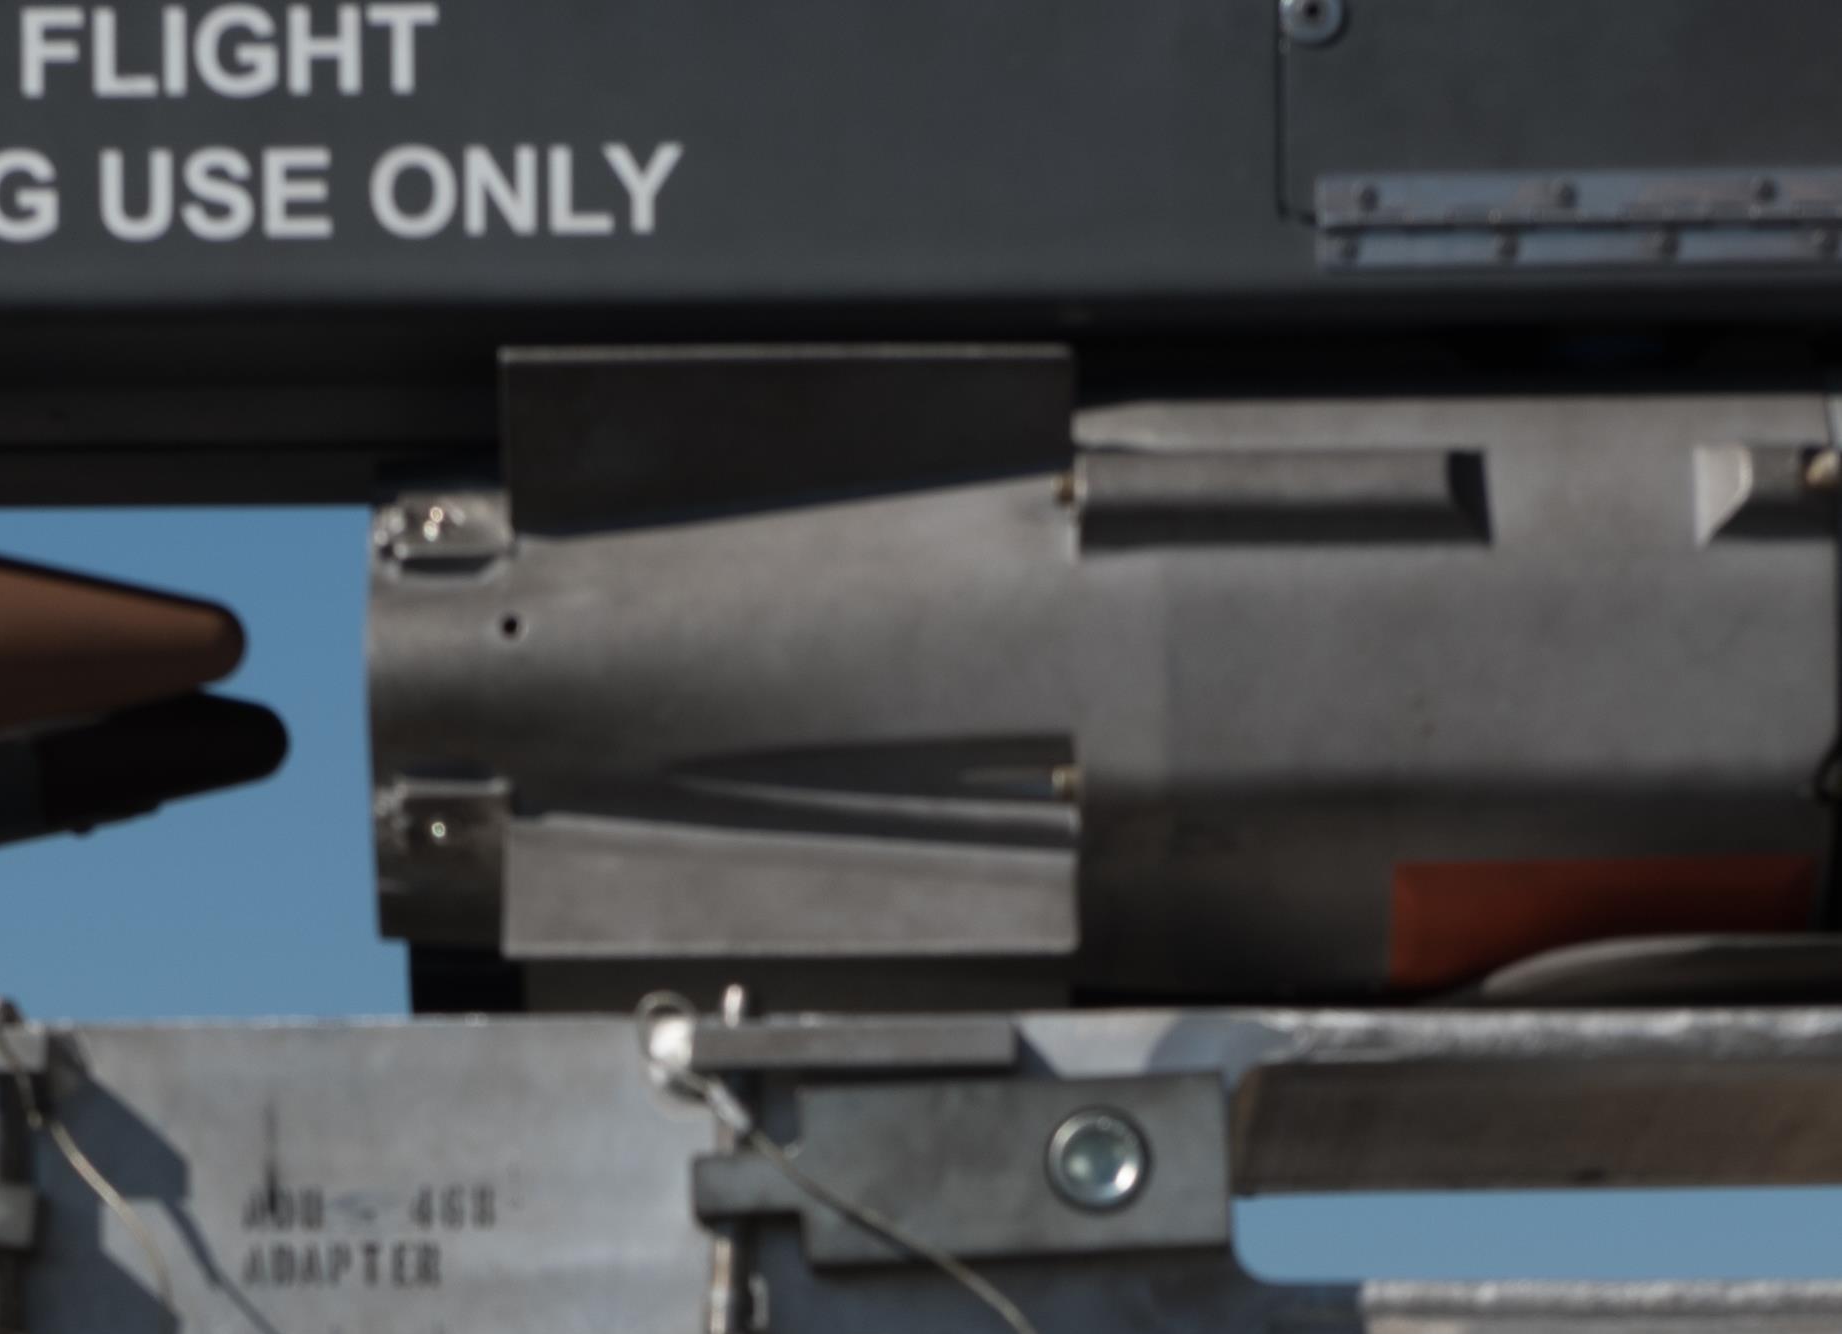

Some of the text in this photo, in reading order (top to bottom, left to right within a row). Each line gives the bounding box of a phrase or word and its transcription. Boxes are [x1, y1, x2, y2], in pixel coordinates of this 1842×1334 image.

[19, 3, 440, 98] FLIGHT
[98, 146, 334, 241] USE
[368, 143, 683, 238] ONLY
[242, 1240, 443, 1291] ADAPTER
